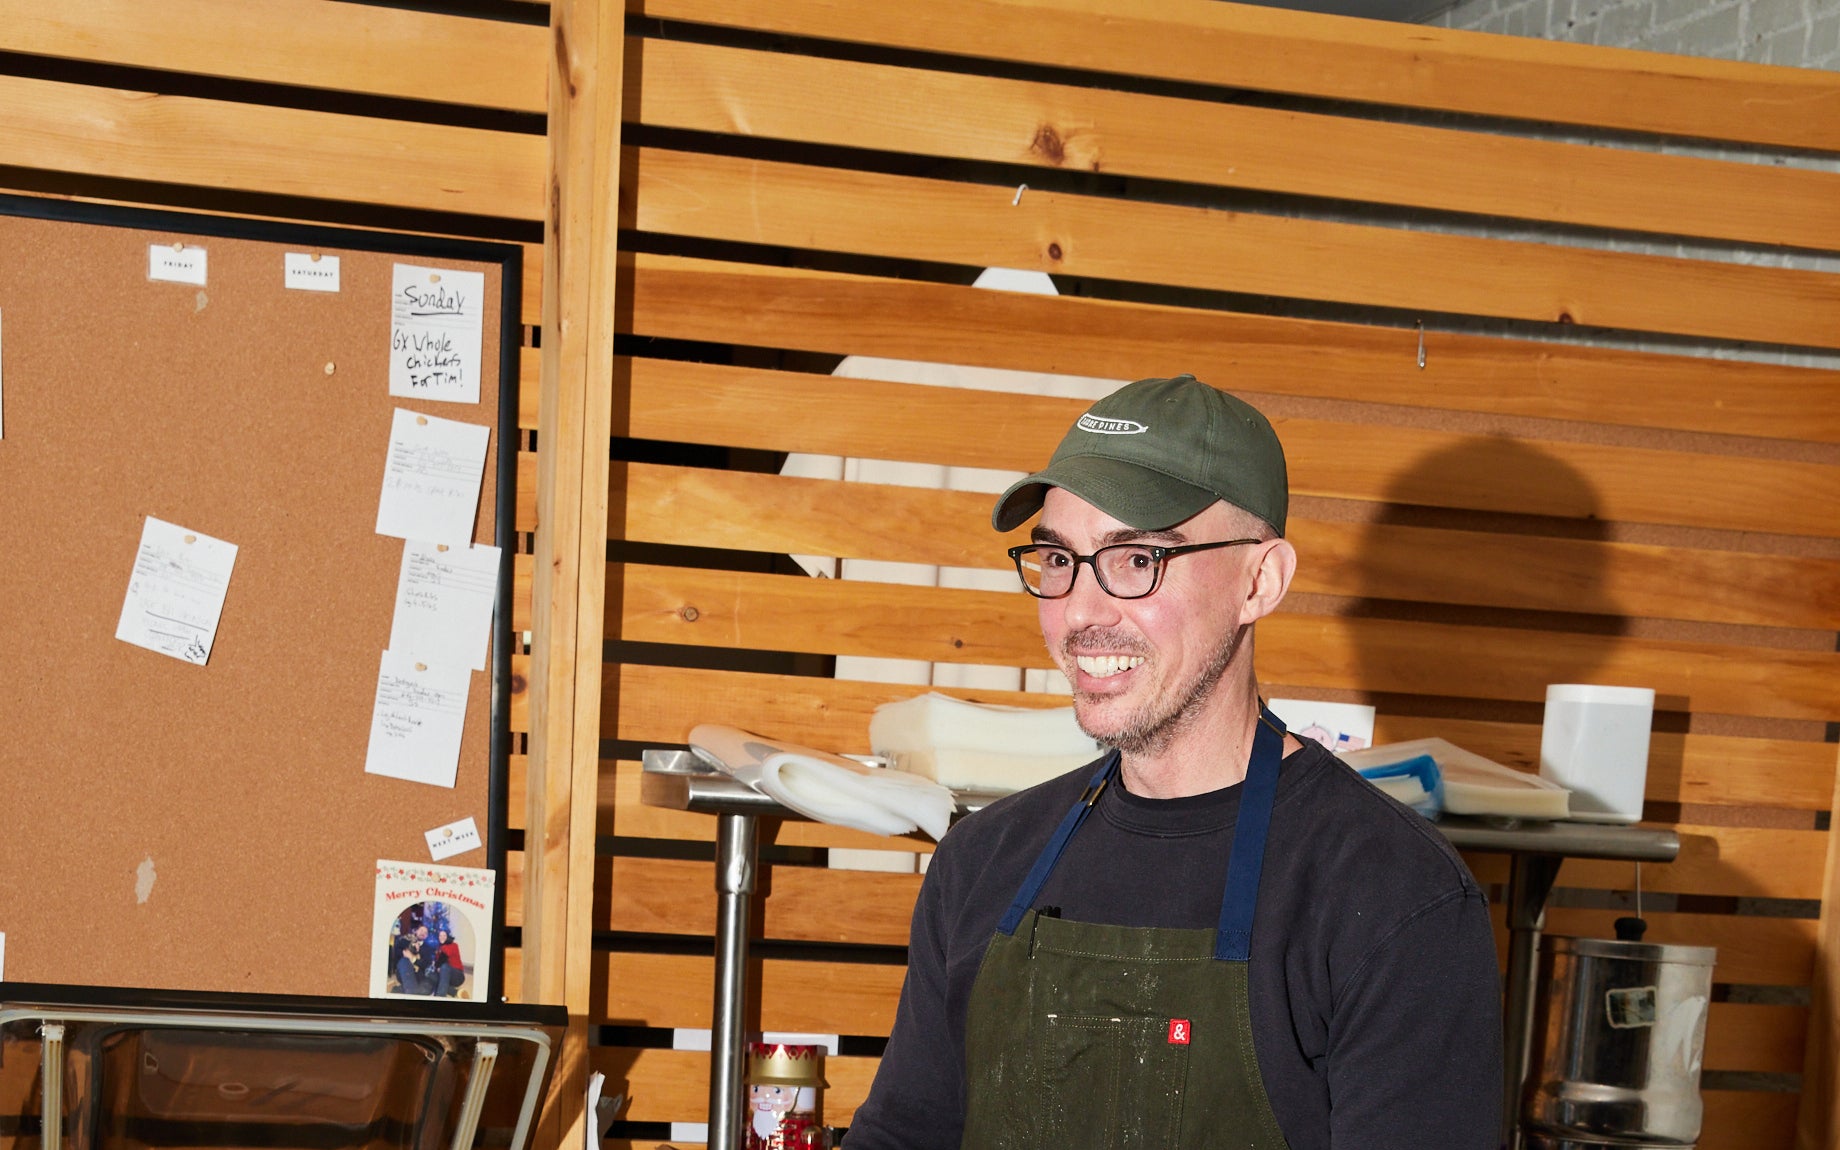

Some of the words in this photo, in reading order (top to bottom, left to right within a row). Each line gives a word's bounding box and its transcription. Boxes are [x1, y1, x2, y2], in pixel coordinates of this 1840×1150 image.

[164, 261, 194, 269] FRIDAY
[292, 269, 334, 277] SATURDAY
[404, 285, 465, 314] Sunday
[413, 331, 453, 352] Whole
[1098, 422, 1130, 431] PINES
[385, 888, 422, 901] Merry
[425, 887, 486, 910] Christmas
[1173, 1023, 1186, 1041] &
